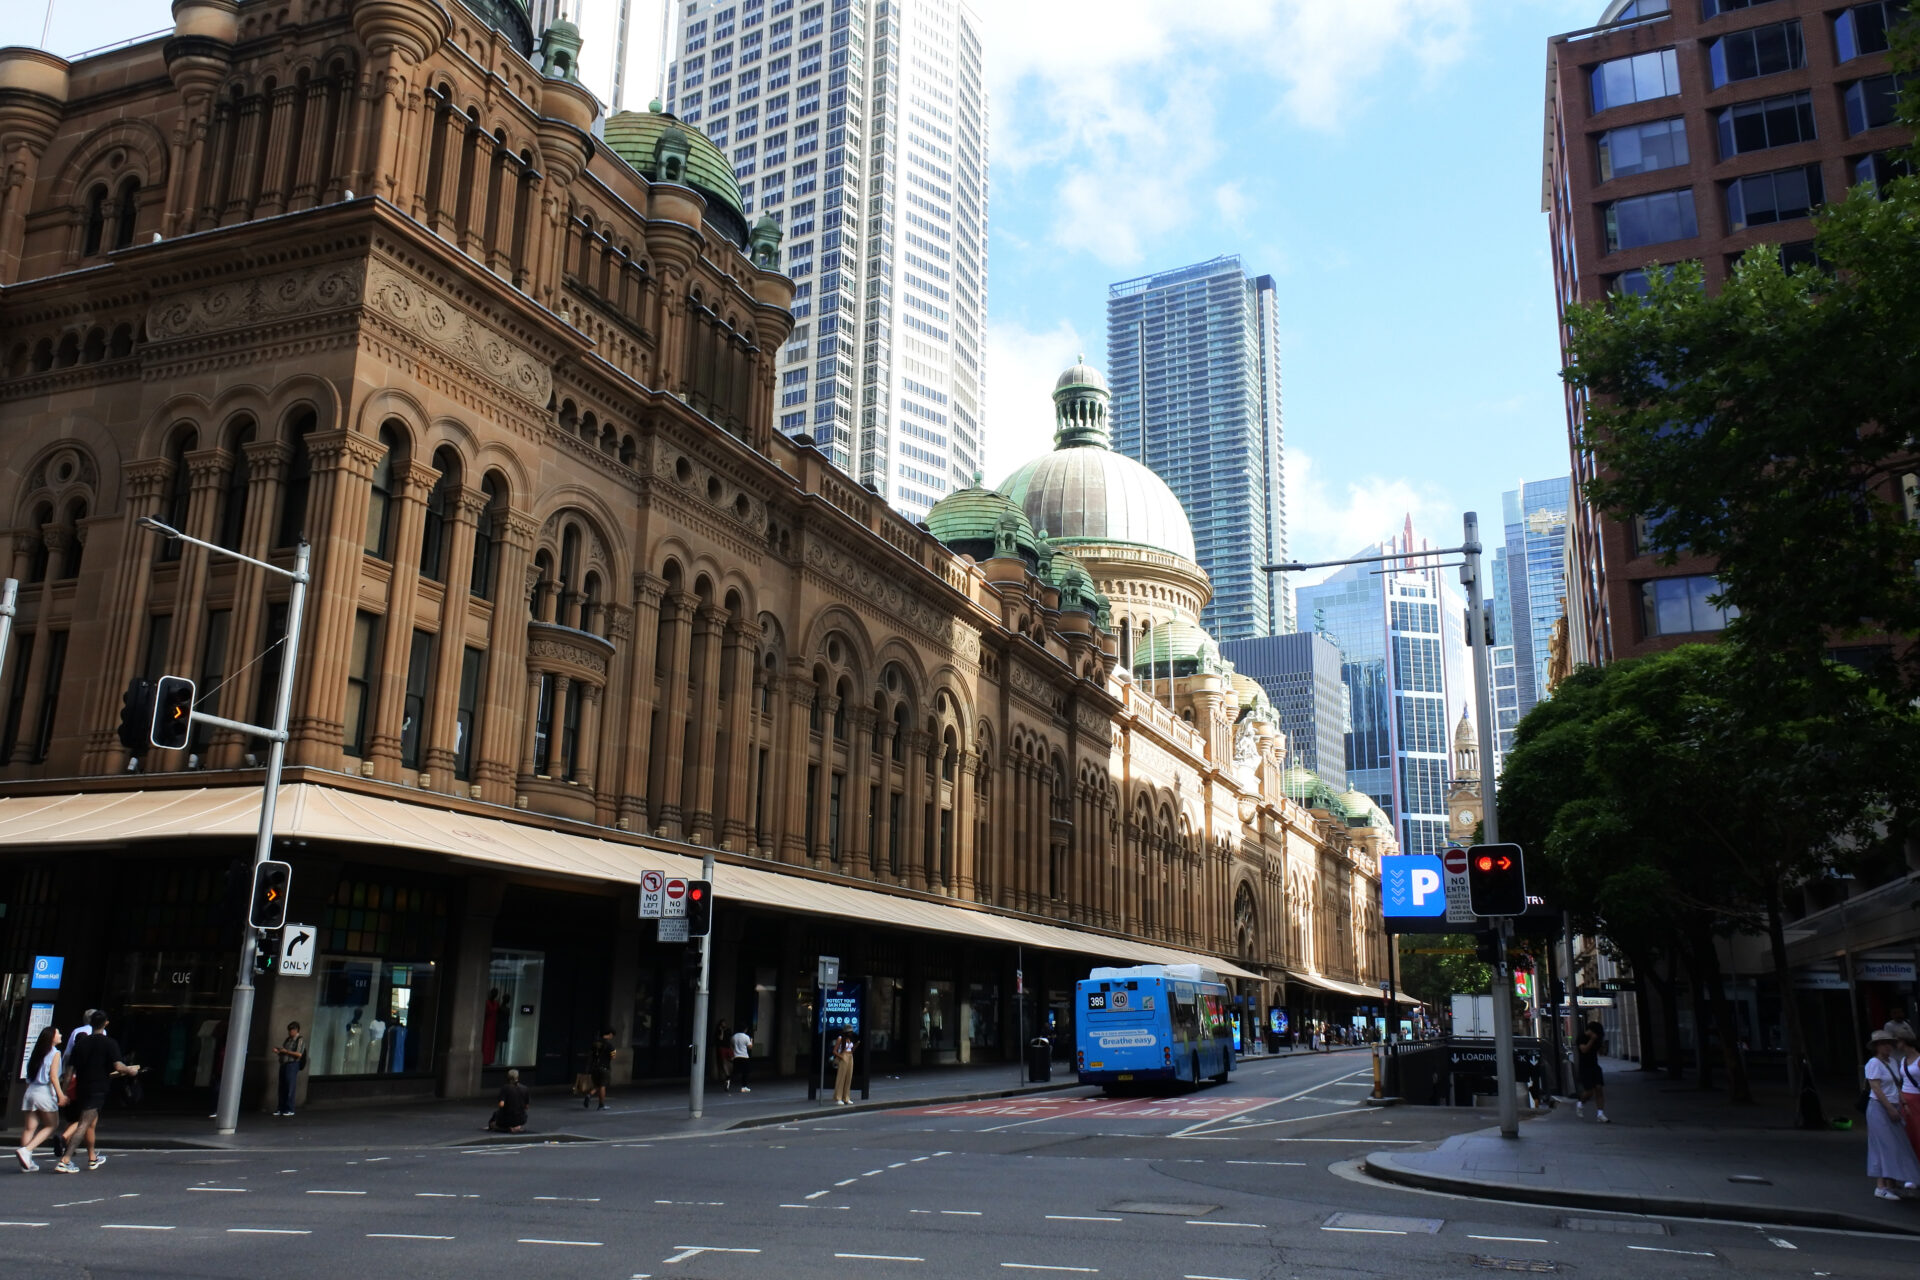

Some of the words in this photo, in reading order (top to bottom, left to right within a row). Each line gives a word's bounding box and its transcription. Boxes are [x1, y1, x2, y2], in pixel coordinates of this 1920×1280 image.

[1451, 877, 1466, 885] NO
[1411, 869, 1440, 906] P
[1526, 895, 1545, 905] TRY
[283, 961, 309, 970] ONLY
[172, 972, 191, 984] CUE
[1114, 996, 1125, 1004] 40
[1103, 1037, 1133, 1045] Breathe
[1095, 1107, 1226, 1116] LANE
